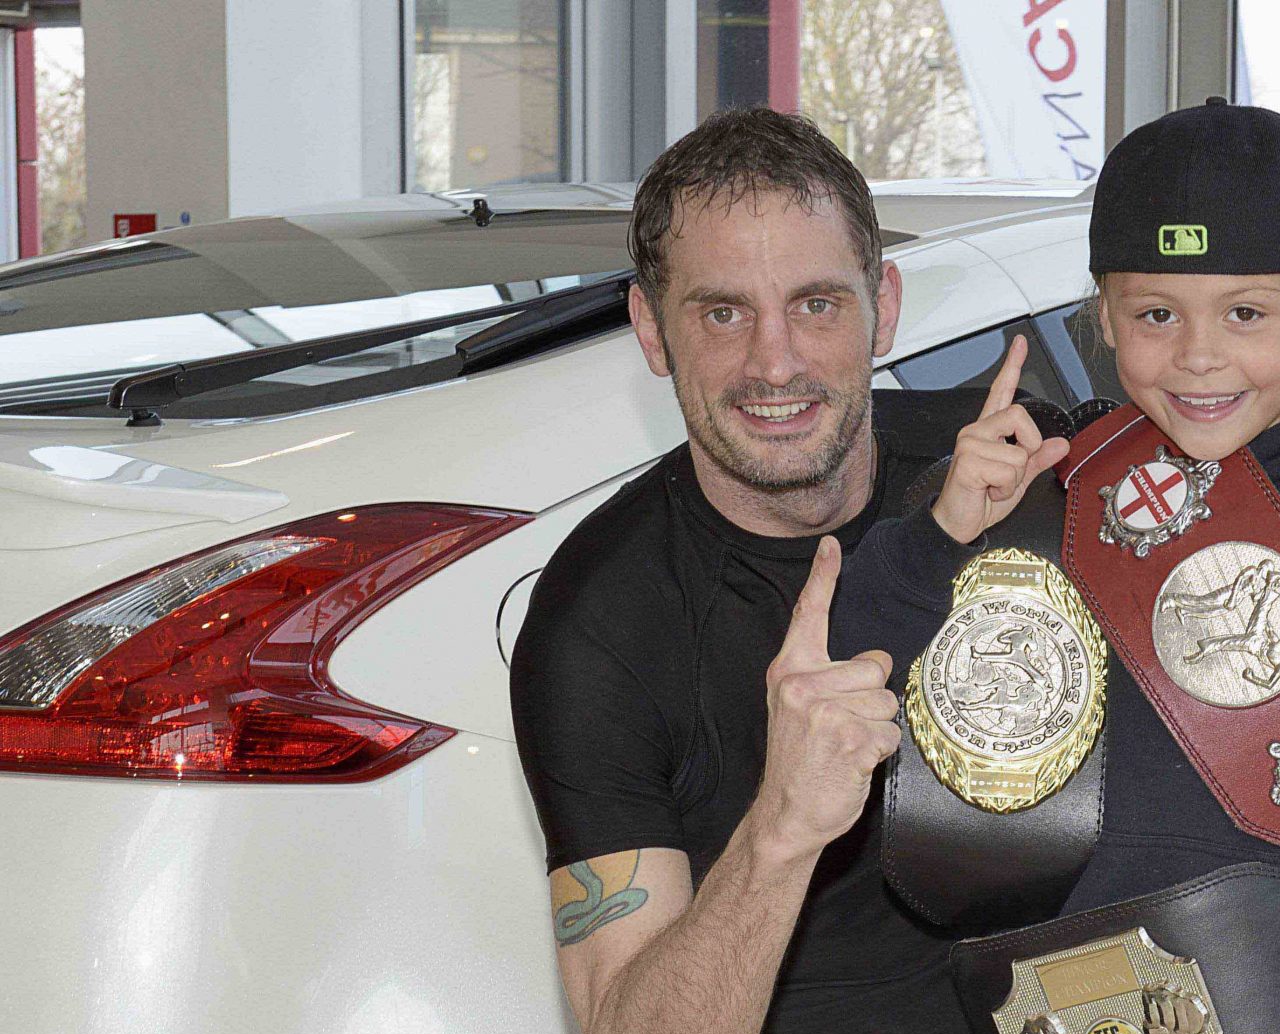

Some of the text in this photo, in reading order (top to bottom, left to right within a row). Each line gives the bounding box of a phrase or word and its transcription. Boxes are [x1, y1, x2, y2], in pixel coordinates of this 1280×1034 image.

[1134, 470, 1170, 521] CHAMPION
[982, 600, 1083, 753] World Ring Sports
